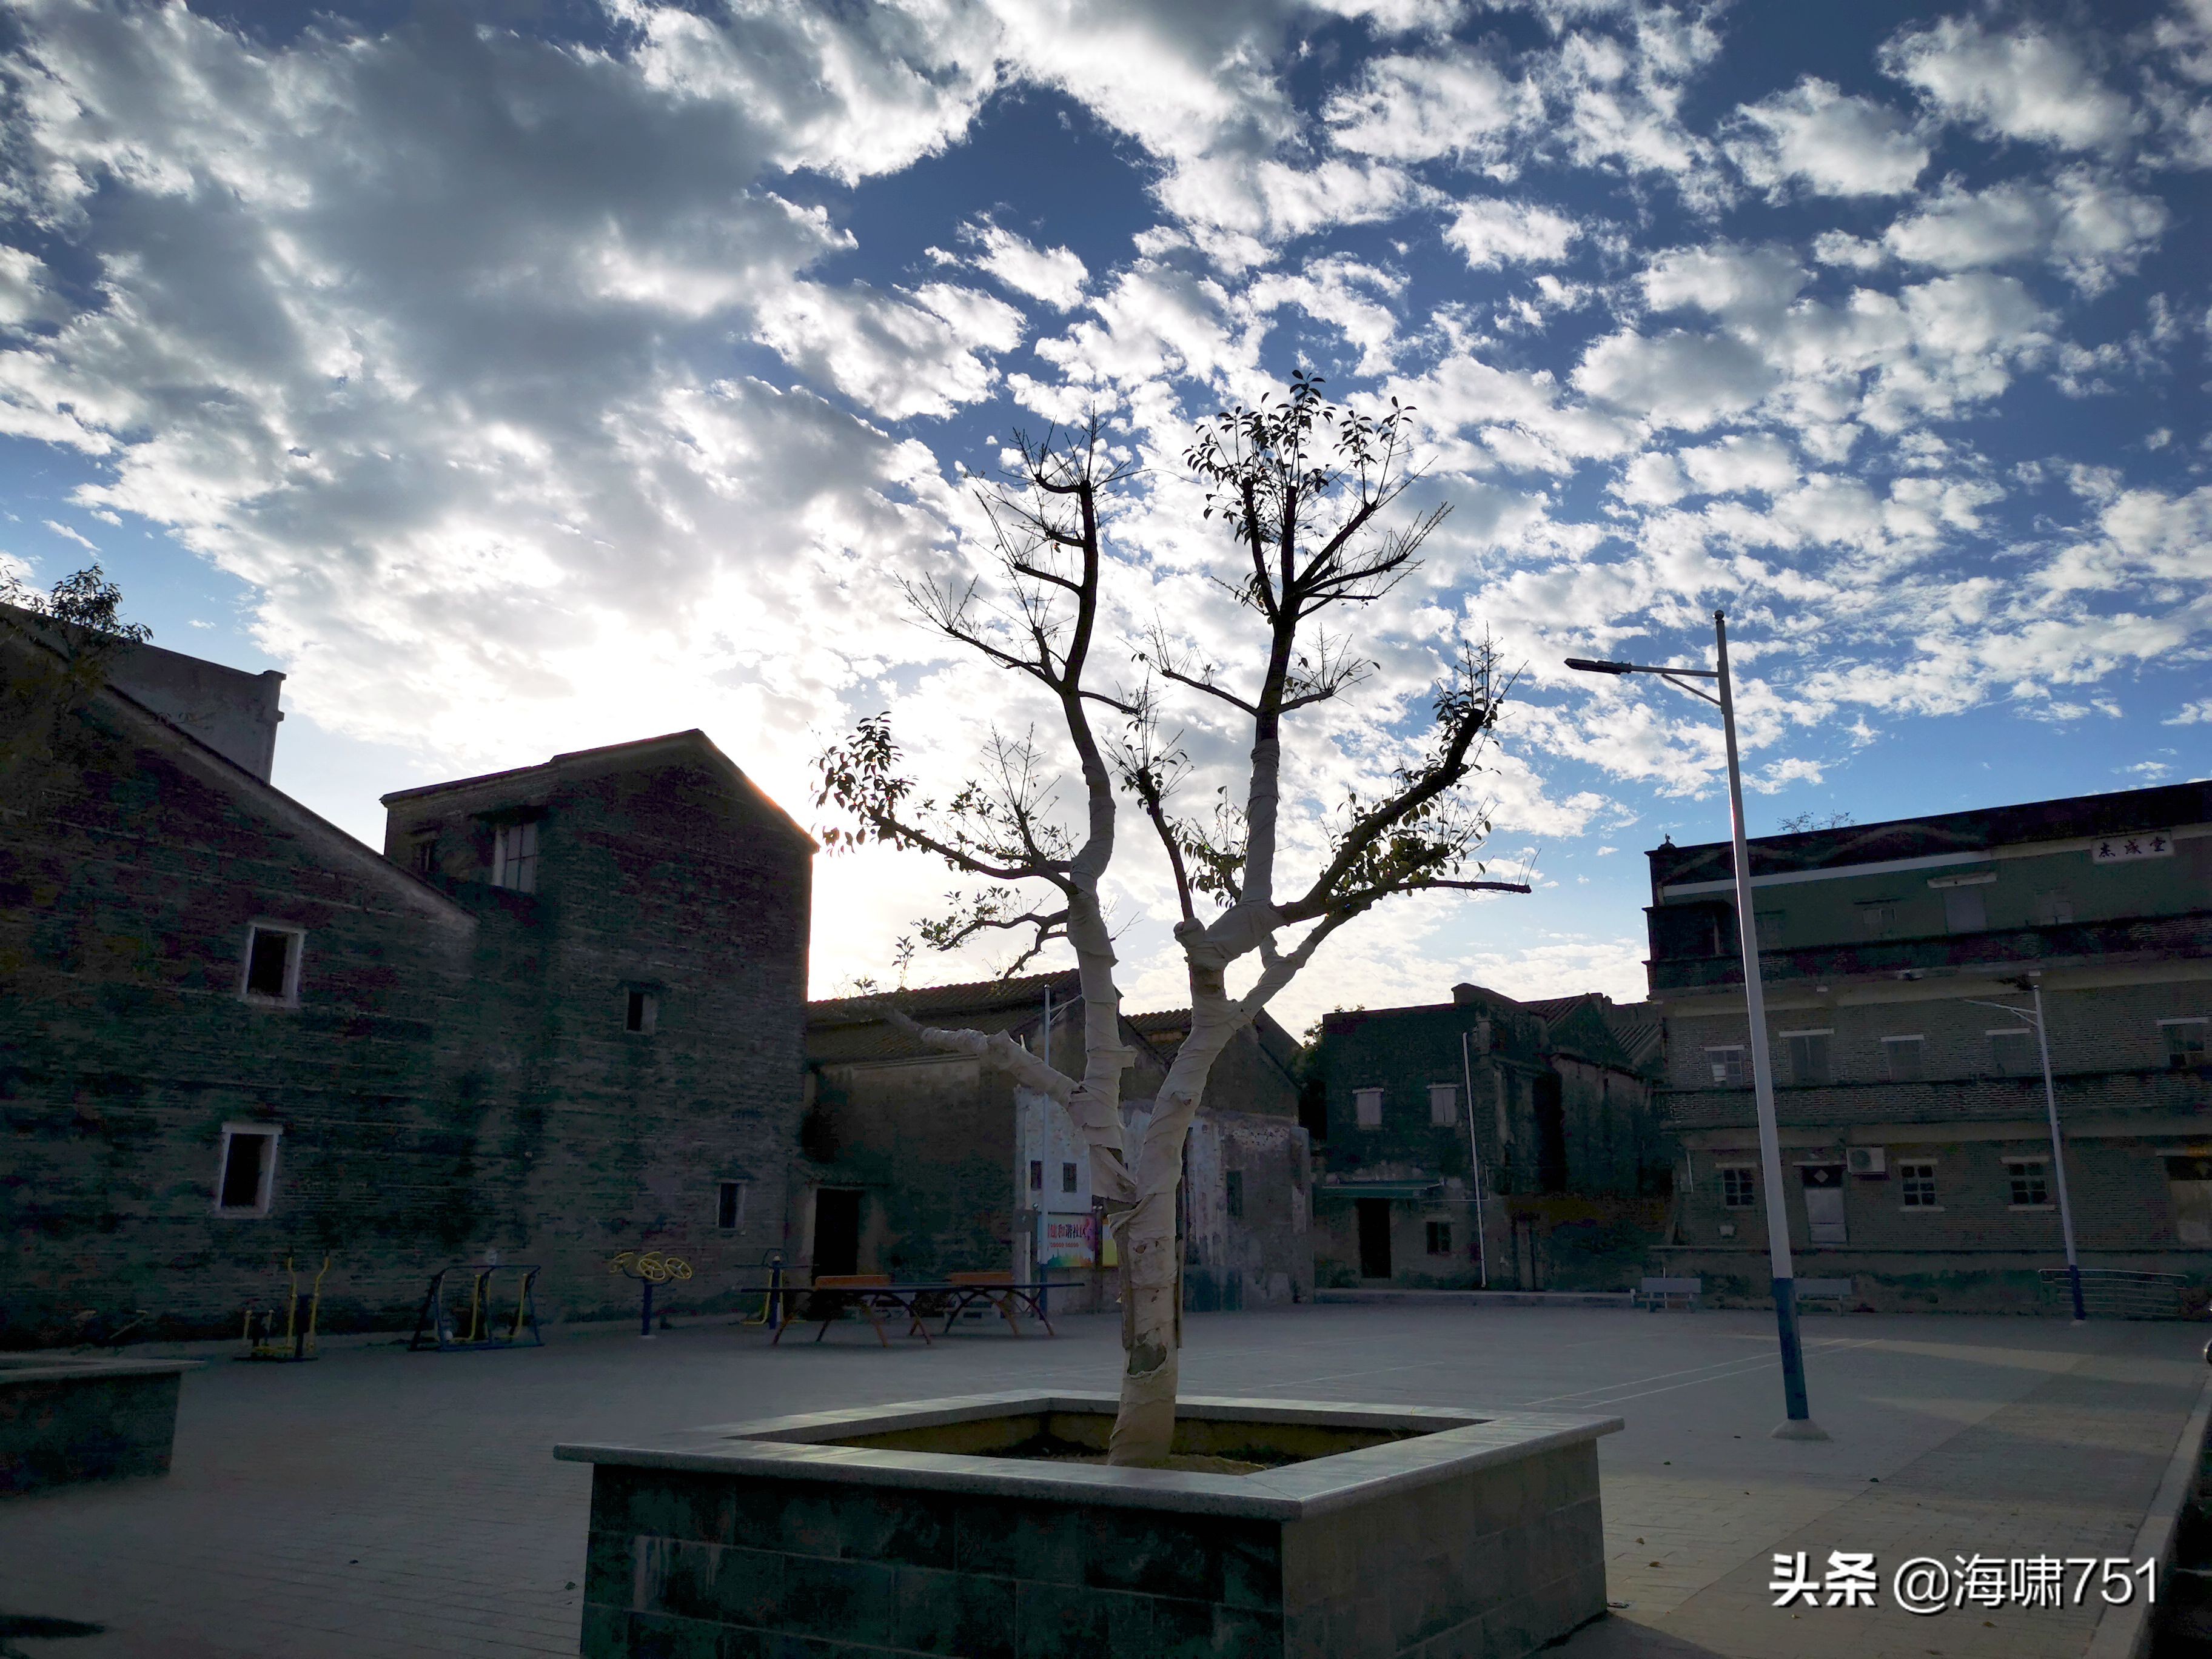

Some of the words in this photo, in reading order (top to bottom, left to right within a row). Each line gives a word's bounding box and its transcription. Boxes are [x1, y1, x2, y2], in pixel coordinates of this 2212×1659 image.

[1048, 1223, 1087, 1239] 建和谐社区
